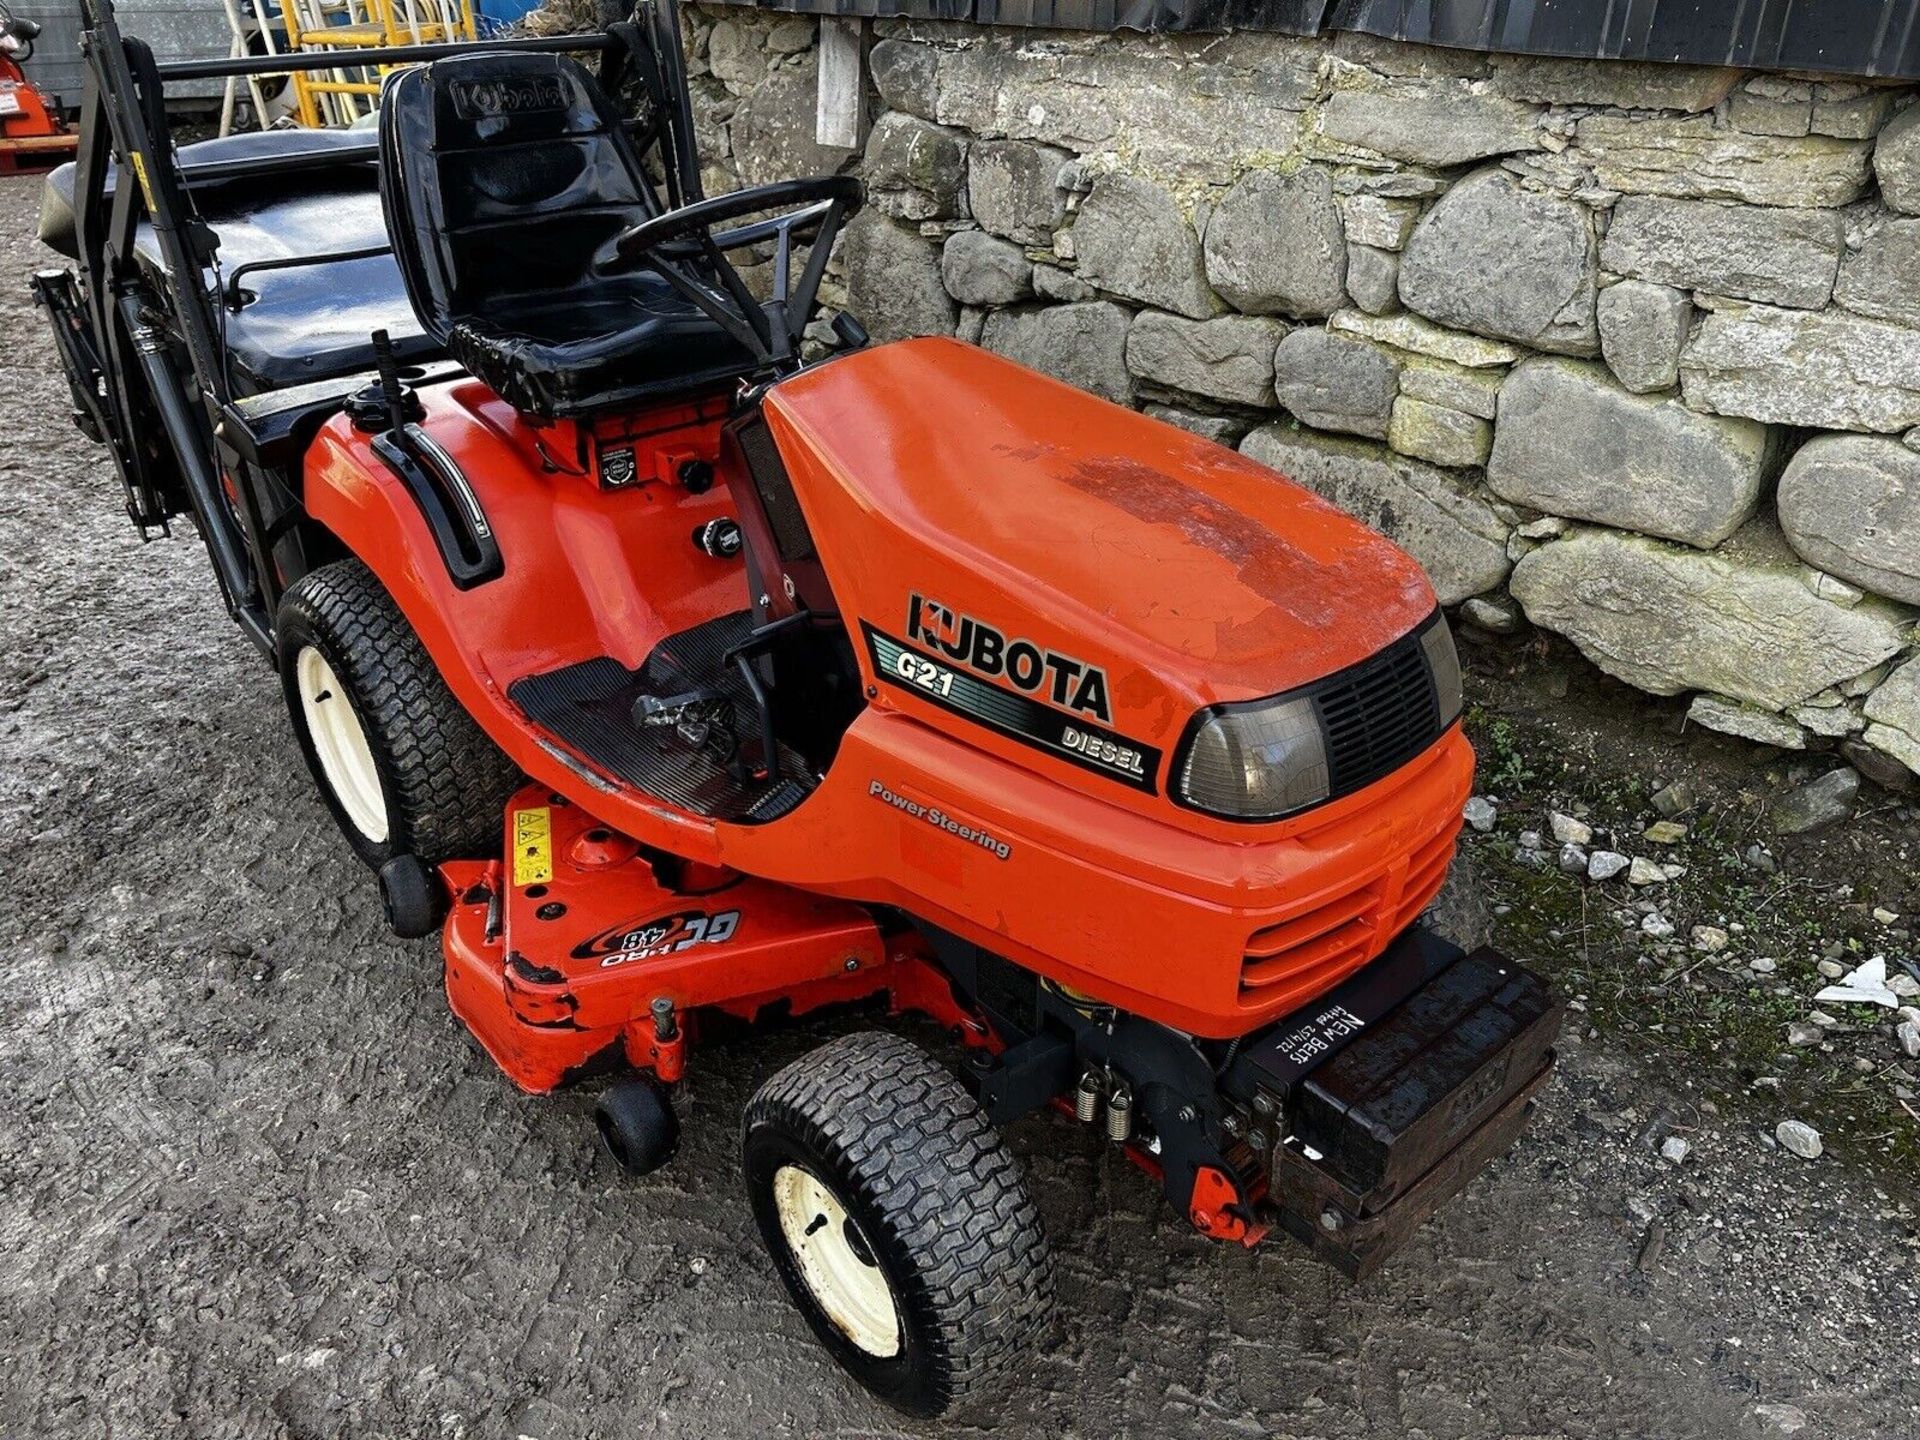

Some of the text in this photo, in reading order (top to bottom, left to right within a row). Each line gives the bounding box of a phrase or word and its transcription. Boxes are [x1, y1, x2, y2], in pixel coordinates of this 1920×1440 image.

[455, 79, 562, 113] Kubota
[897, 651, 954, 697] G21
[908, 590, 1113, 725] KUBOTA
[1061, 726, 1144, 775] DIESEL
[621, 928, 667, 952] 48
[1275, 1025, 1316, 1053] 25/4/22
[1289, 1013, 1365, 1065] NEW BELTS
